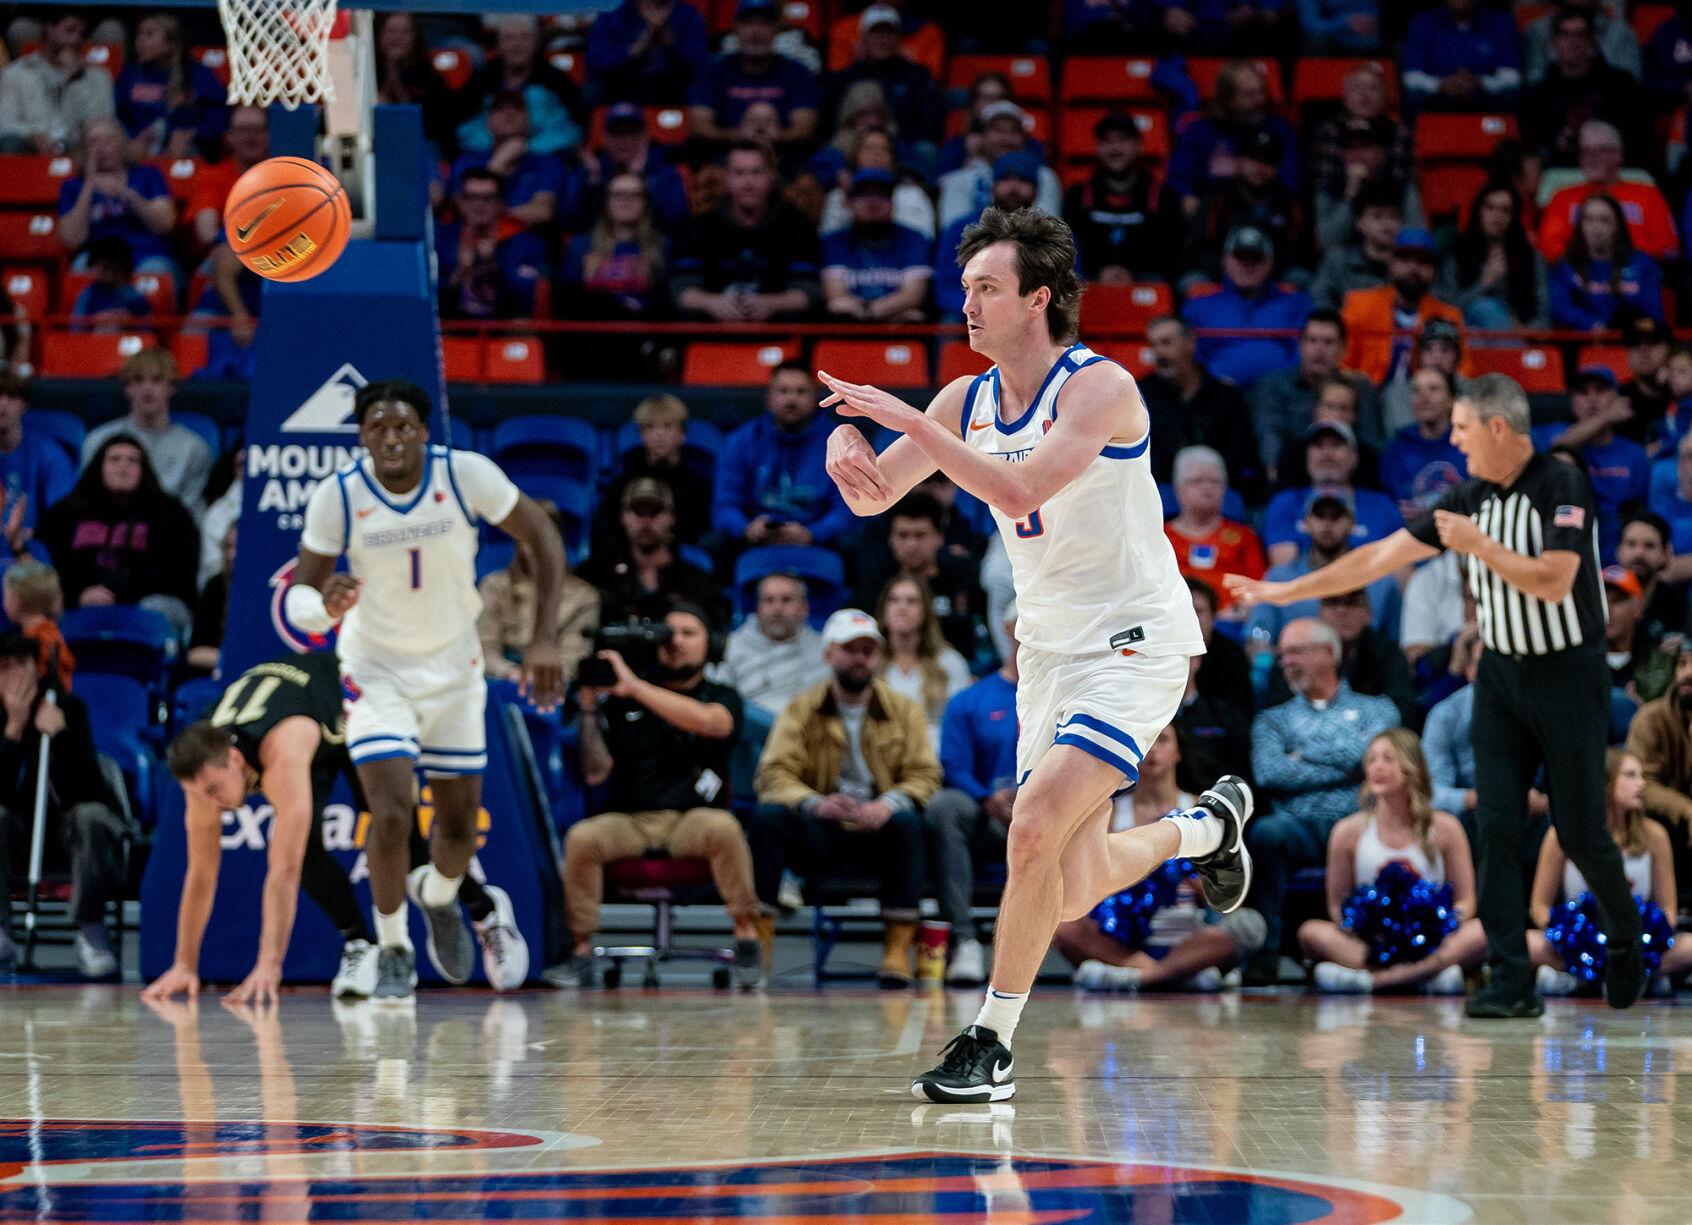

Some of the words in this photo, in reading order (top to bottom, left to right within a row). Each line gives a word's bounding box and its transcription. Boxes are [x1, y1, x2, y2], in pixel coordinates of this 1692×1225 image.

[248, 444, 370, 478] MOUN
[407, 547, 422, 591] 1
[211, 676, 282, 728] 11
